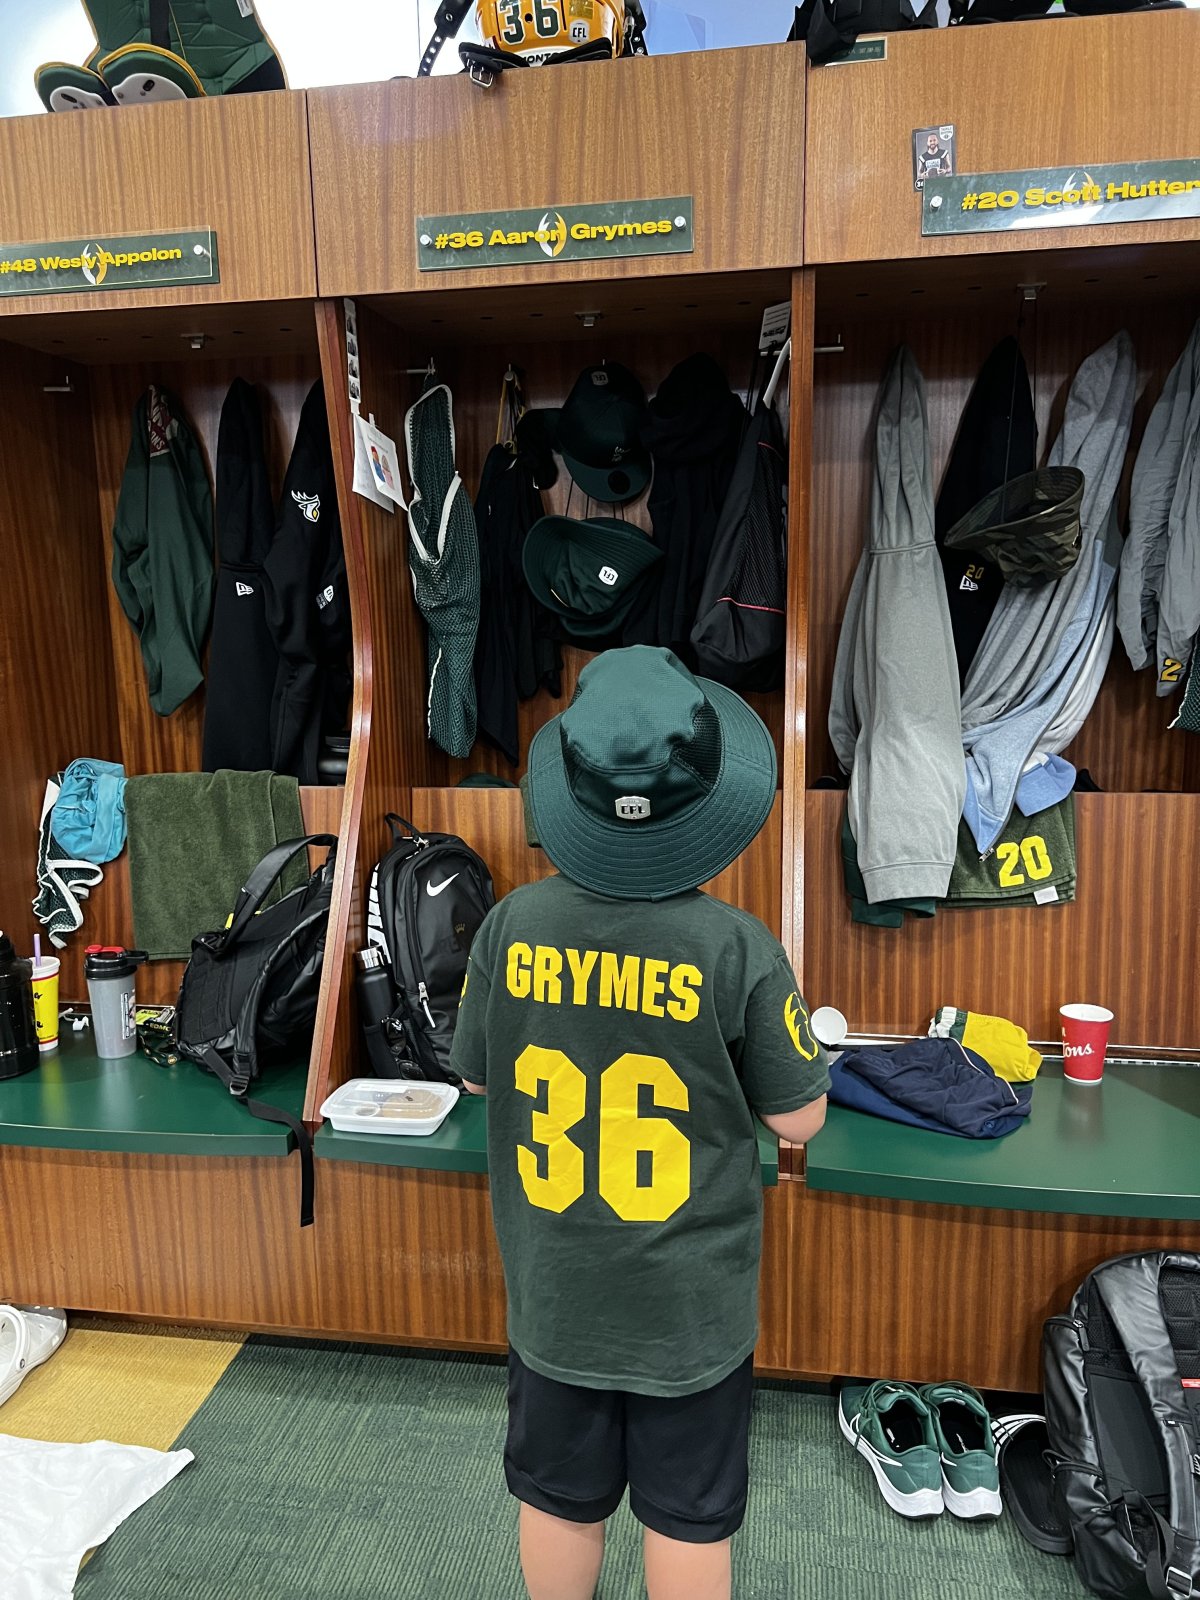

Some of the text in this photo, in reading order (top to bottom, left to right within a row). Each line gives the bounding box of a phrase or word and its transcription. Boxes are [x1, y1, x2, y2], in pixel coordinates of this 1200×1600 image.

[499, 0, 560, 45] 36
[571, 27, 587, 39] CFL
[962, 179, 1200, 210] #20 Scott Hutter
[435, 220, 672, 250] #36 Aaron Grymes
[0, 247, 182, 274] #48 Wesly Appolon
[966, 564, 985, 580] 20
[996, 835, 1053, 888] 20
[506, 941, 704, 1023] GRYMES
[514, 1043, 691, 1222] 36
